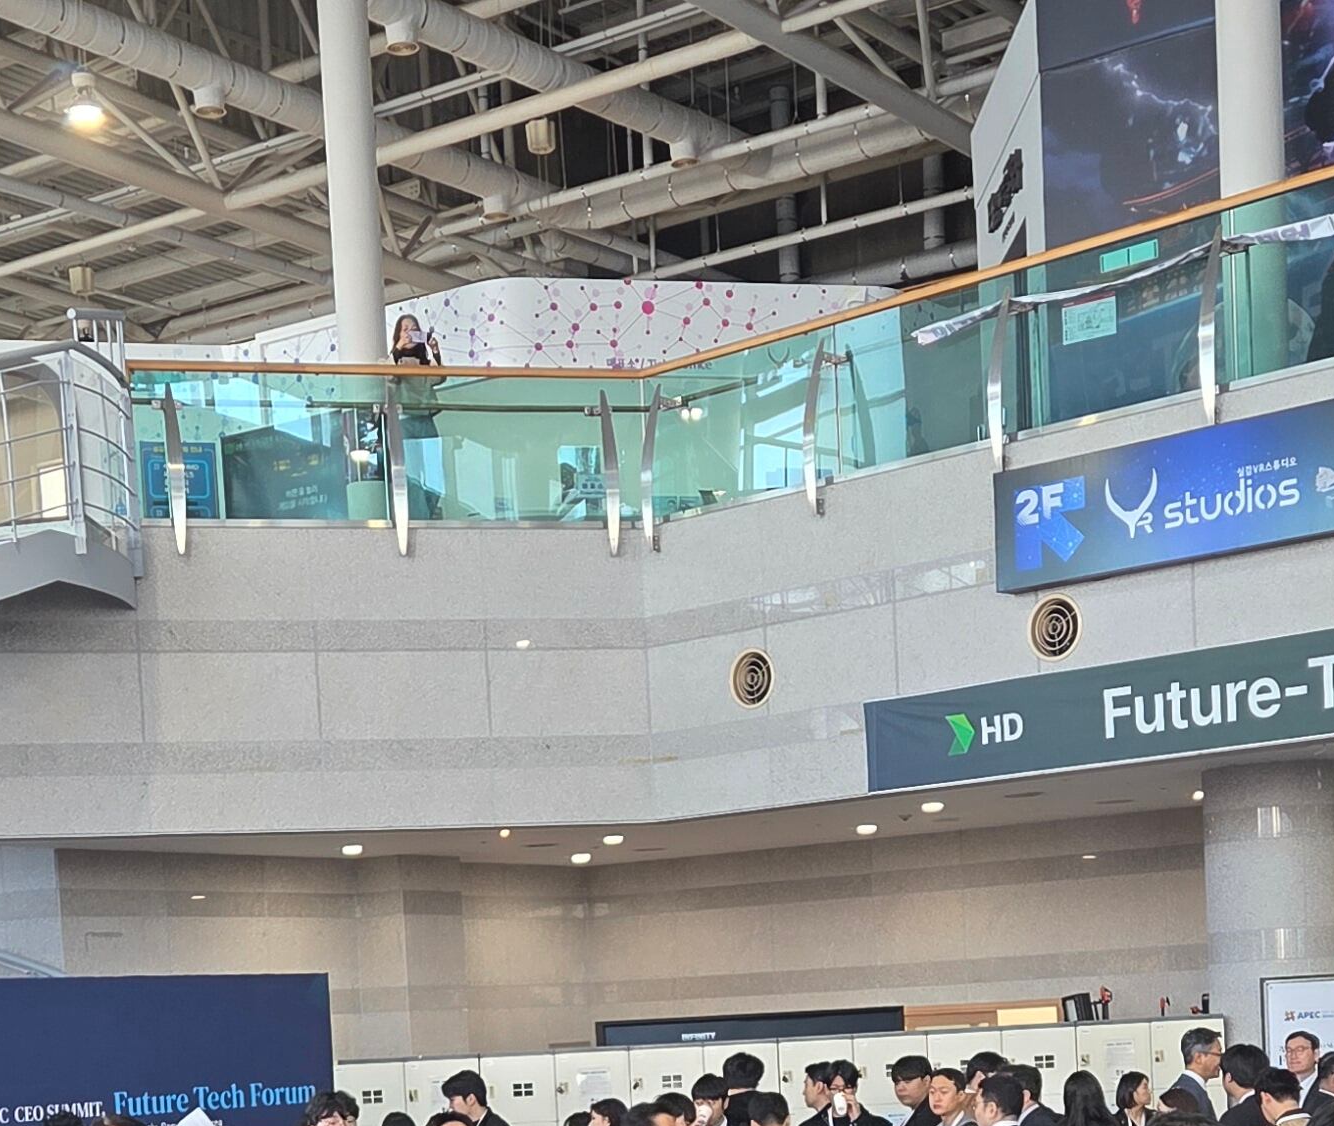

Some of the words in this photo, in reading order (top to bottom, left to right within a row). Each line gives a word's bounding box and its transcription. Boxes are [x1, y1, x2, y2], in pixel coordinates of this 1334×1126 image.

[1236, 456, 1298, 478] 실감VR스튜디오
[1015, 482, 1064, 528] 2F
[1163, 478, 1300, 530] studios
[980, 712, 1023, 745] HD
[1297, 1011, 1320, 1019] APEC
[14, 1105, 45, 1123] CEO
[113, 1089, 189, 1118] Future
[191, 1085, 250, 1111] Tech
[250, 1081, 317, 1108] Forum
